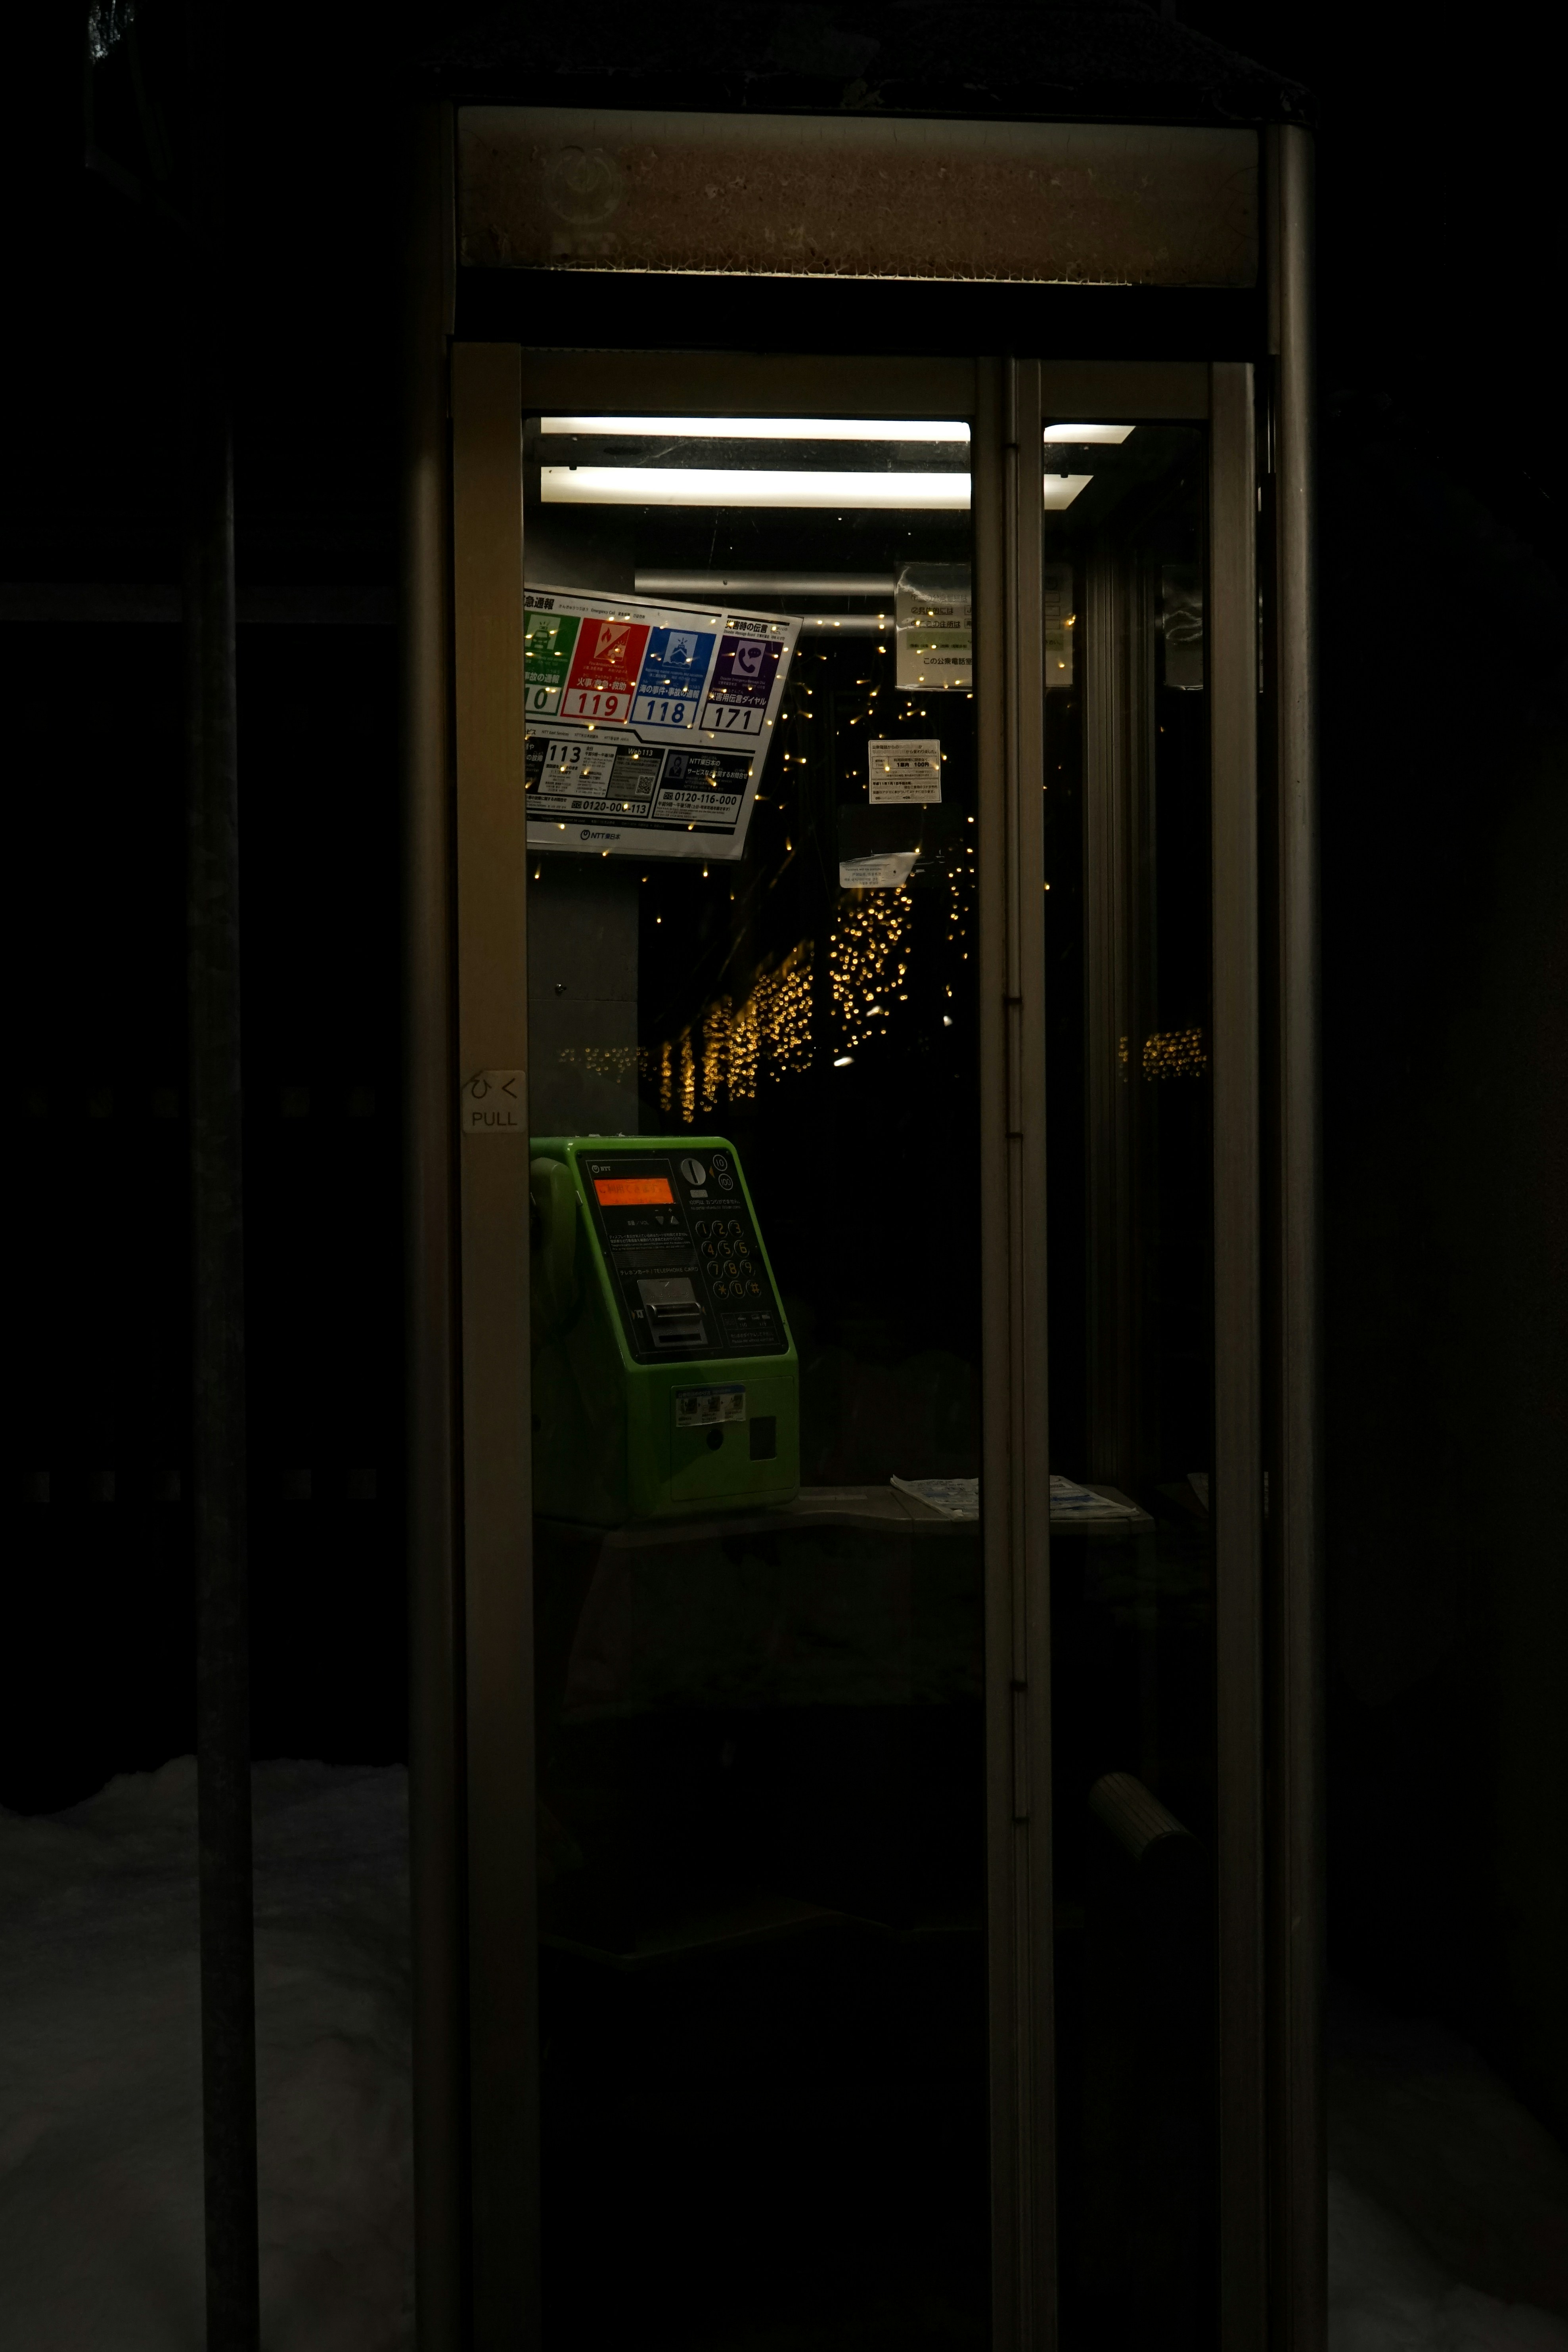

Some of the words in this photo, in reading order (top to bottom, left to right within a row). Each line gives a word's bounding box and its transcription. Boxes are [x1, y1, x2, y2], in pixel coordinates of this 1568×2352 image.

[524, 595, 555, 609] 急通報
[578, 693, 618, 716] 119
[647, 700, 685, 723] 118
[716, 707, 752, 730] 171
[550, 745, 581, 763] 113
[674, 792, 737, 805] 0120-116-000
[472, 1111, 518, 1126] PULL
[702, 1224, 707, 1234] 1
[717, 1223, 726, 1235] 2
[733, 1222, 741, 1233] 3
[707, 1244, 714, 1255] 4
[723, 1243, 731, 1254] 5
[739, 1242, 747, 1253] 6
[713, 1264, 718, 1275] 7
[728, 1262, 737, 1274] 8
[745, 1262, 752, 1273] 9
[735, 1283, 743, 1295] 0
